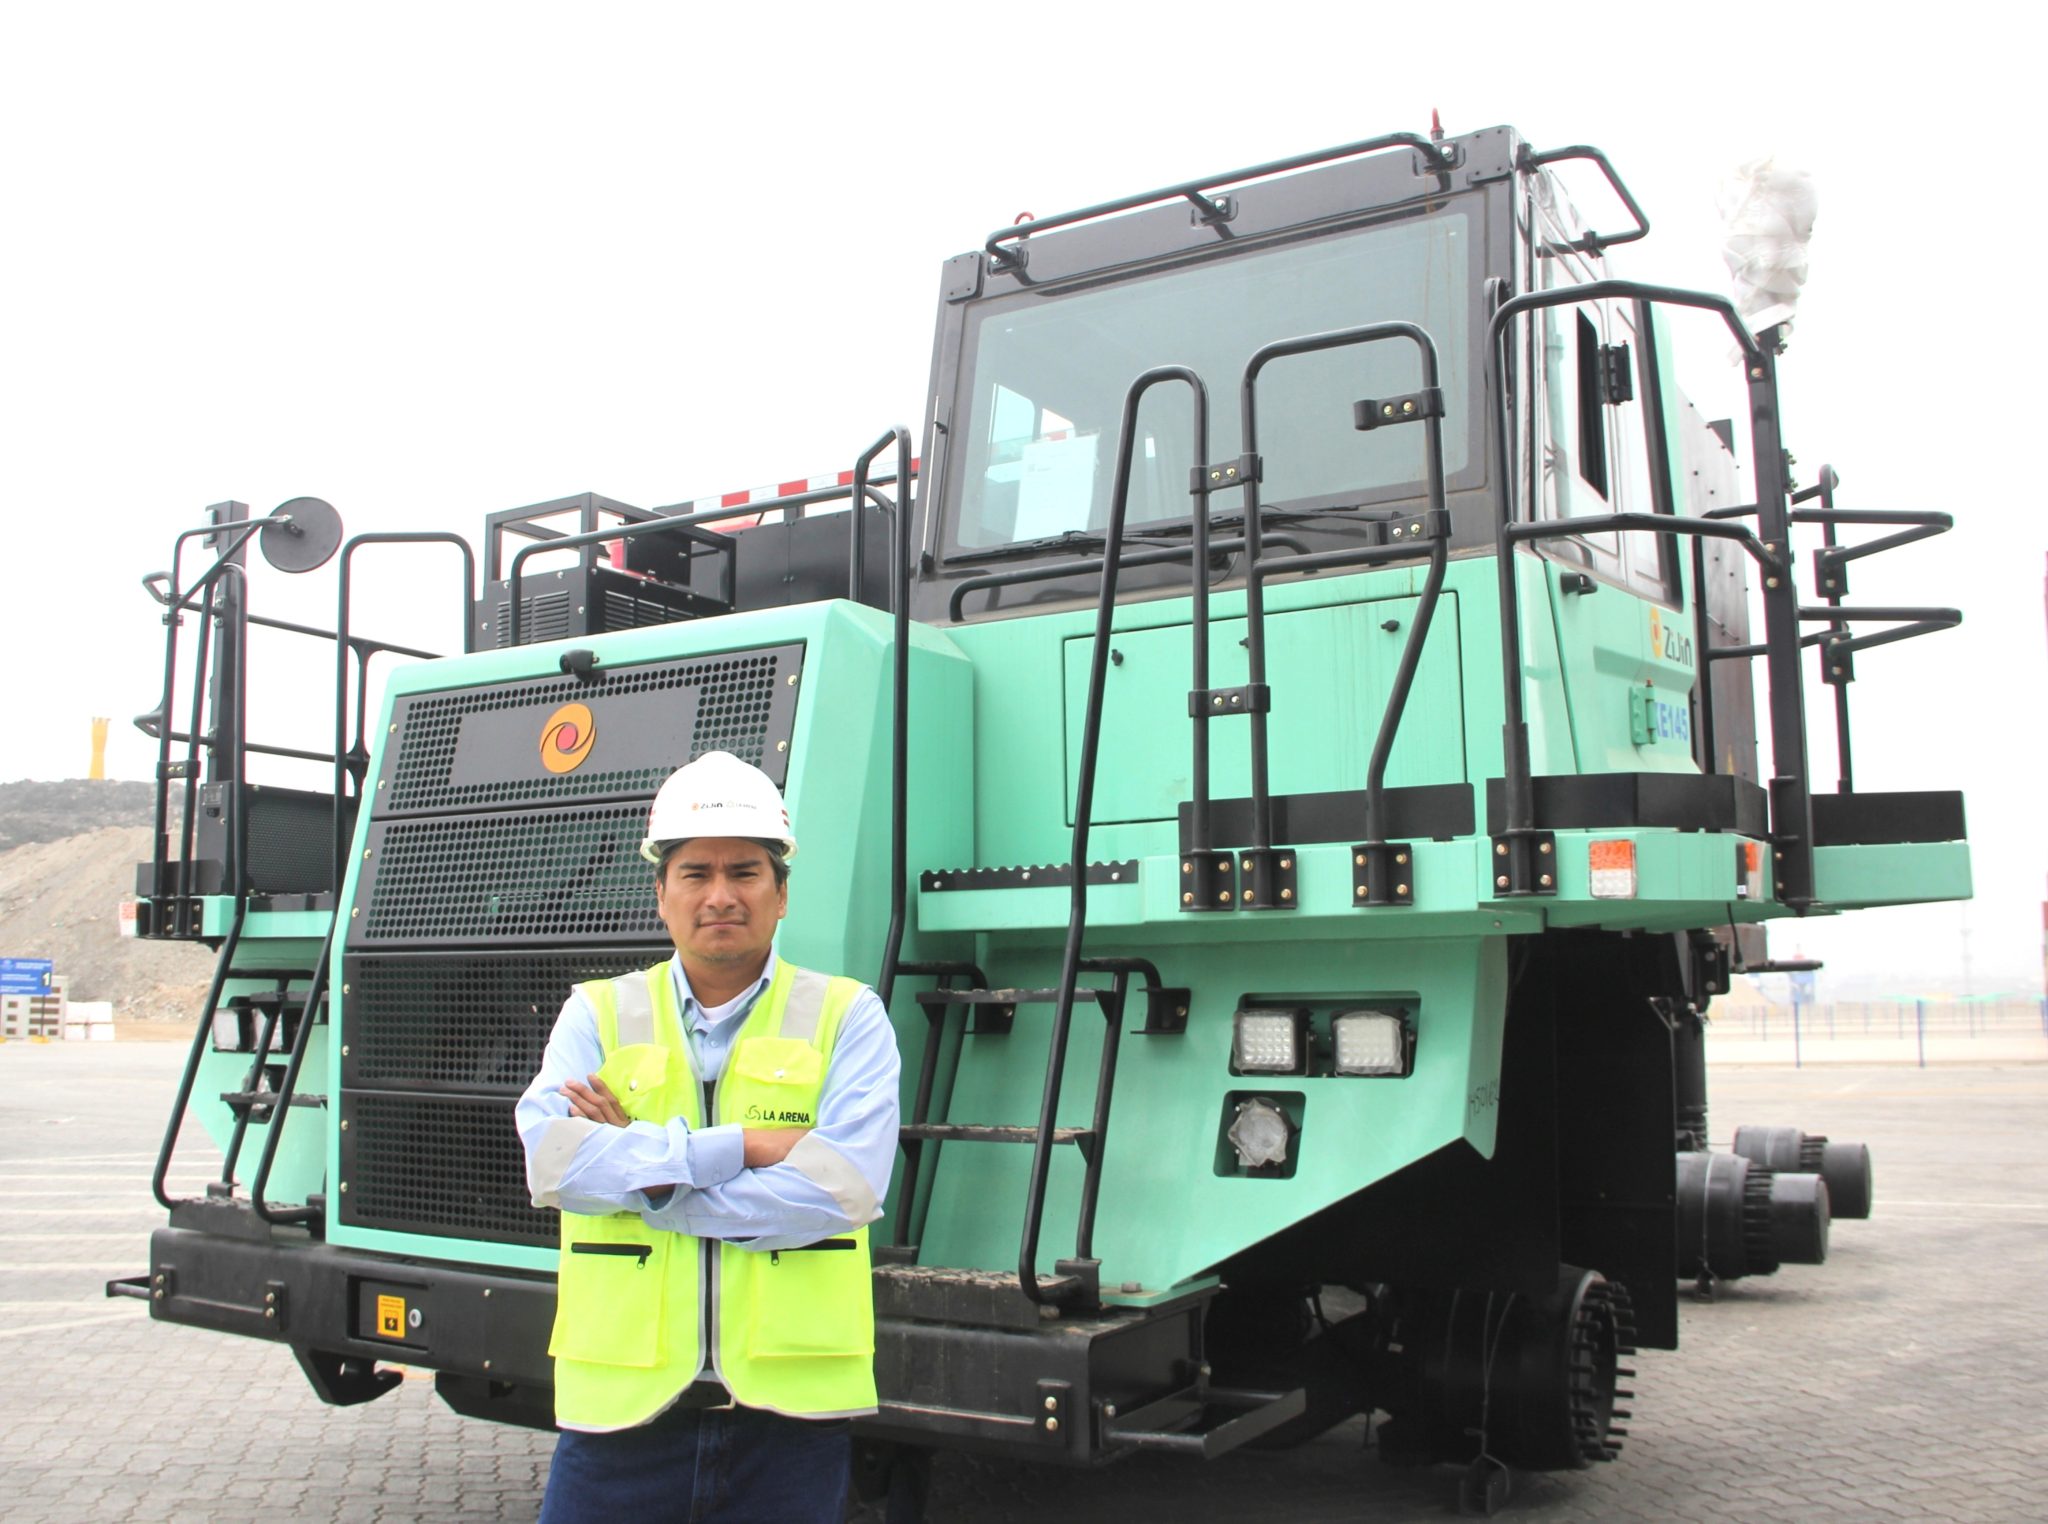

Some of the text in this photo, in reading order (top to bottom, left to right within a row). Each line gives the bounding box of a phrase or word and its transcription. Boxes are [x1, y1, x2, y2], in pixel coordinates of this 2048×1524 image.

[42, 972, 50, 987] 1
[763, 1109, 810, 1124] LA ARENA
